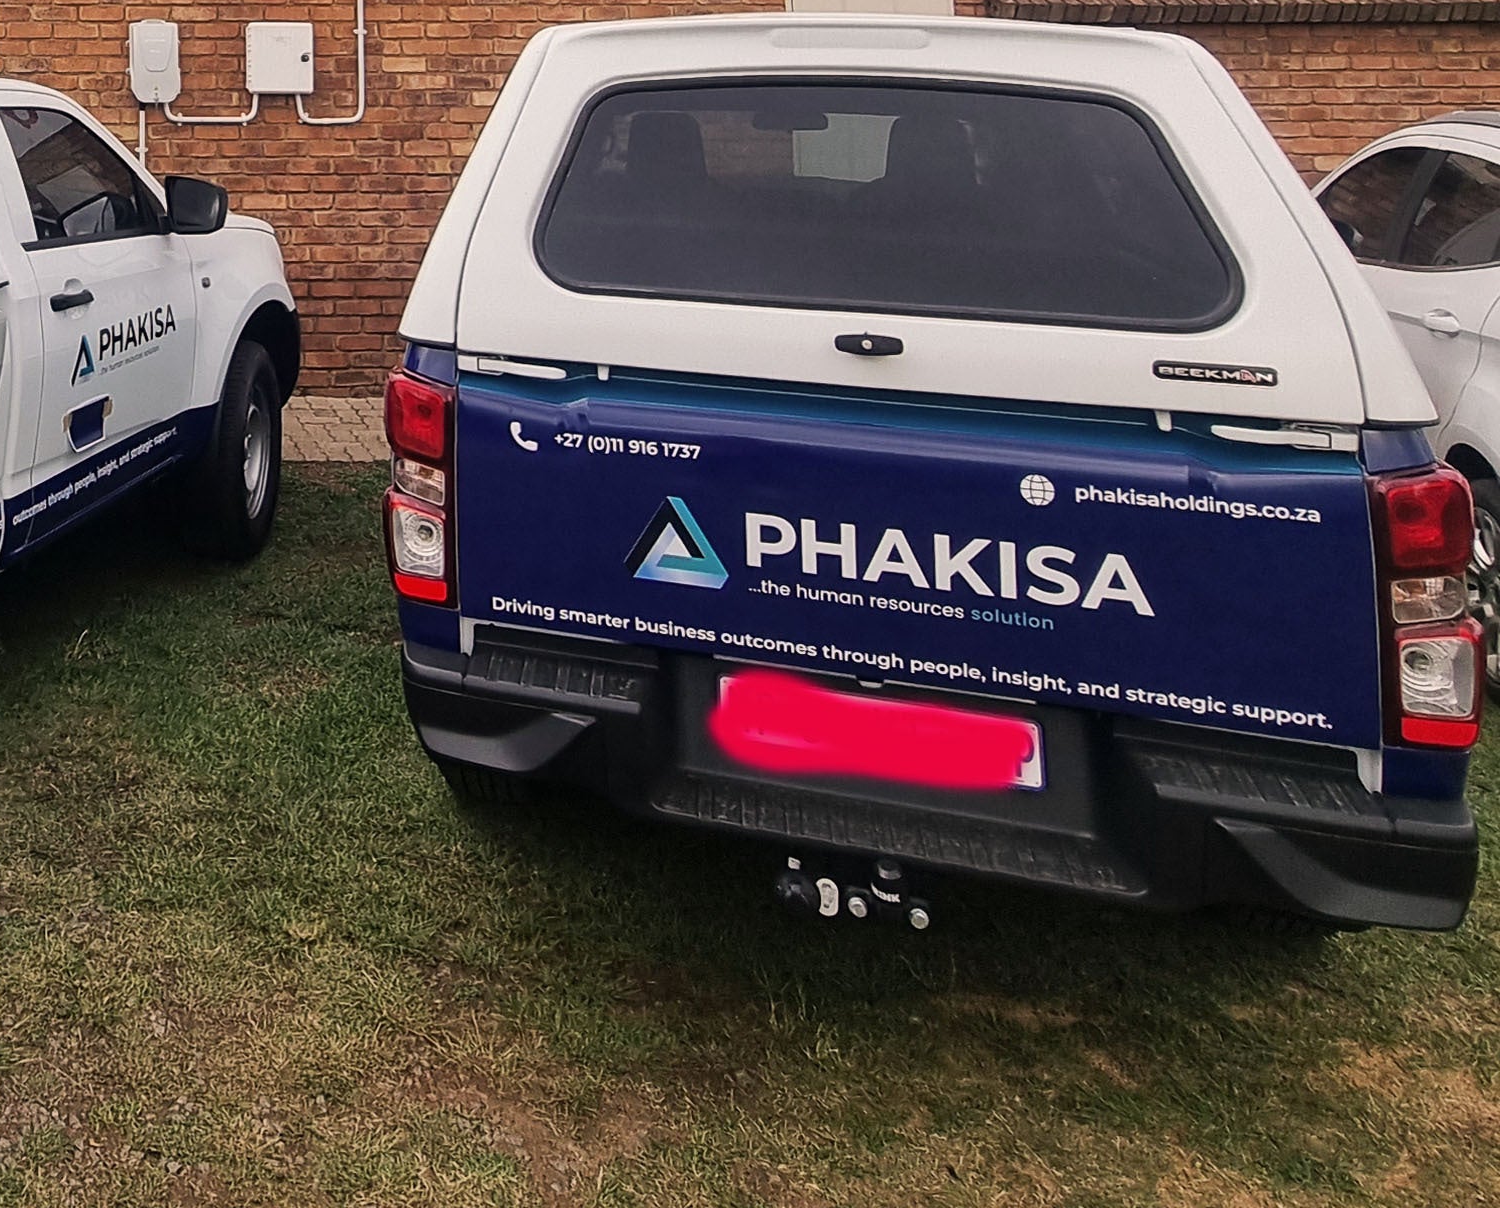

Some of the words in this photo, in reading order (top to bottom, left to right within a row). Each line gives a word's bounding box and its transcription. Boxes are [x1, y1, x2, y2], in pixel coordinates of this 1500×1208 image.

[98, 303, 177, 362] PHAKISA
[1158, 366, 1273, 383] BEEKMAN
[553, 432, 583, 449] +27
[587, 434, 624, 454] (0)11
[628, 439, 658, 456] 916
[661, 442, 701, 460] 1737
[1074, 484, 1321, 523] phakisaholdings.co.za
[744, 511, 1155, 617] PHAKISA
[748, 578, 791, 596] ...the
[796, 583, 864, 607] human
[869, 596, 965, 620] resources
[970, 606, 1055, 630] solution
[491, 596, 556, 621] Driving
[559, 609, 631, 629] smarter
[634, 616, 716, 642] business
[720, 630, 818, 656] outcomes
[822, 644, 904, 671] through
[910, 656, 987, 683] people,
[991, 666, 1072, 695] insight,
[1077, 680, 1120, 700] and
[1125, 686, 1227, 715] strategic
[1231, 702, 1334, 730] support.
